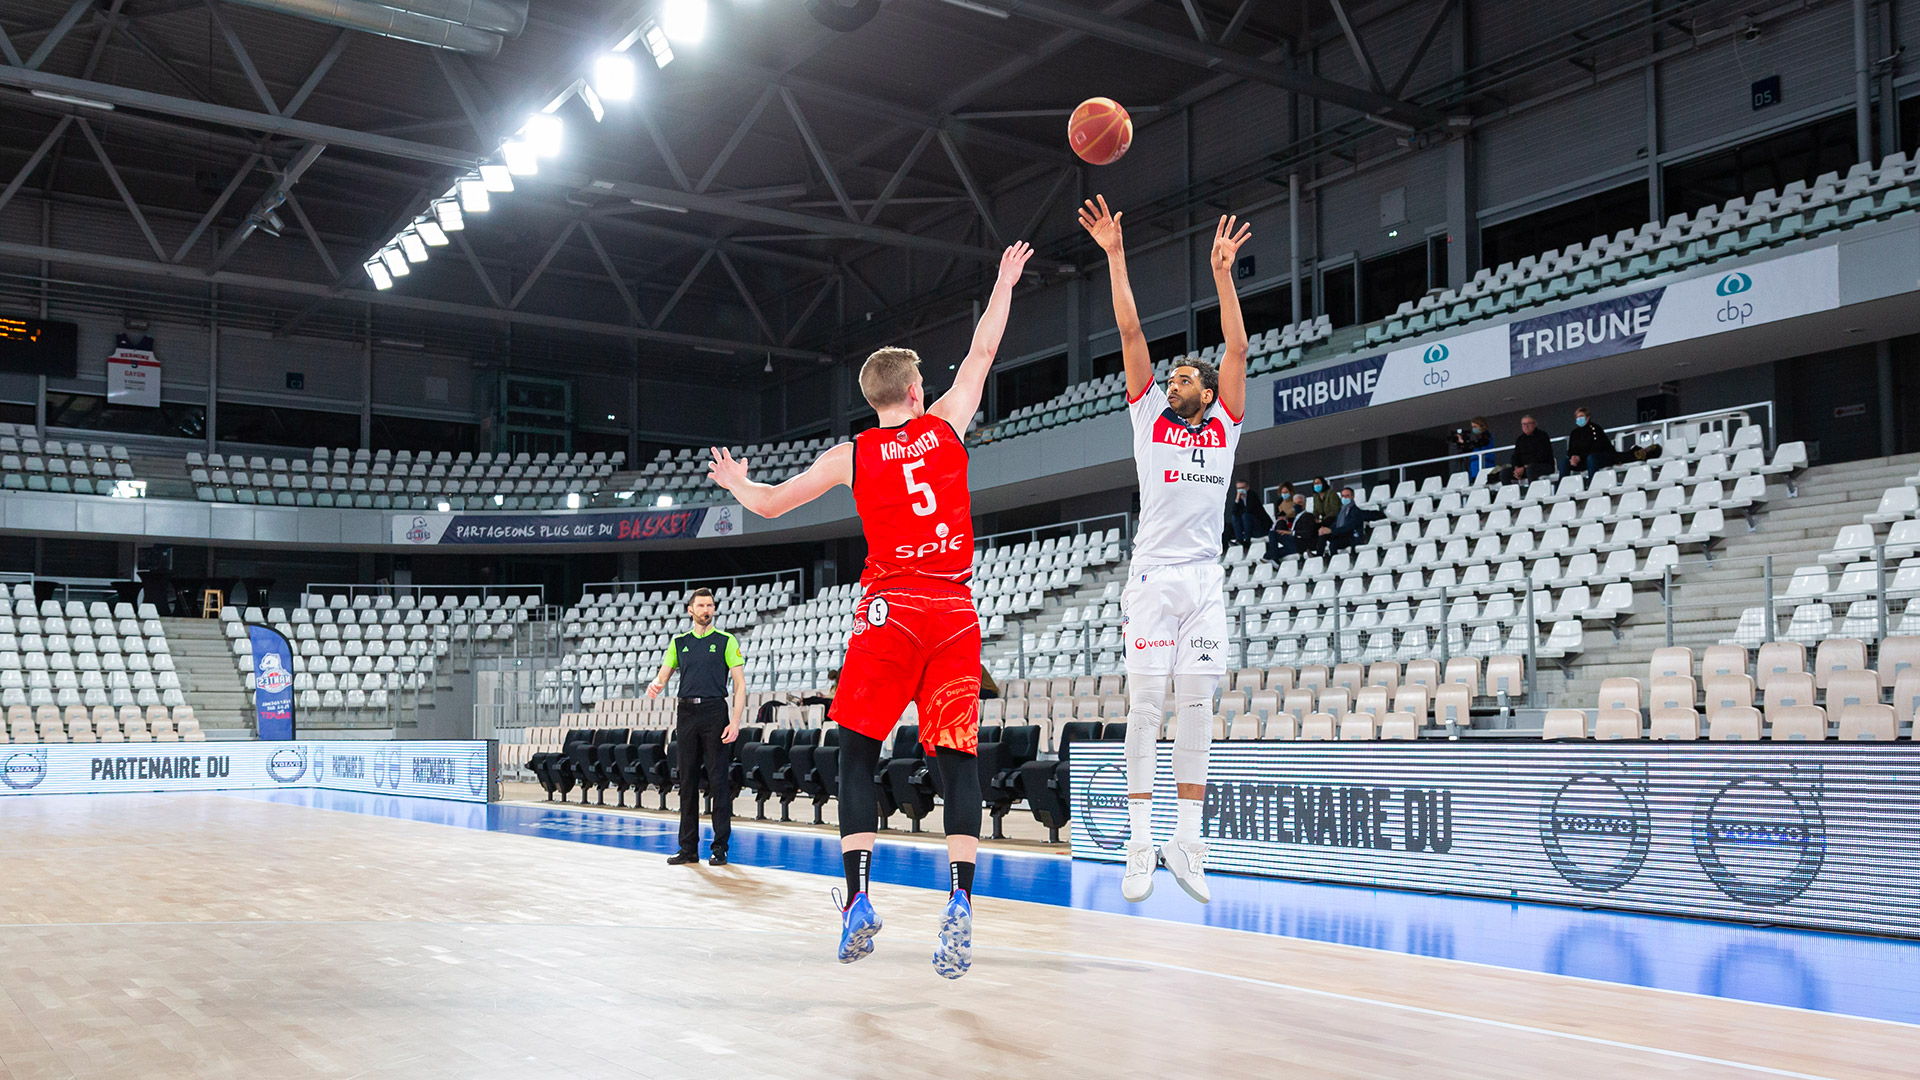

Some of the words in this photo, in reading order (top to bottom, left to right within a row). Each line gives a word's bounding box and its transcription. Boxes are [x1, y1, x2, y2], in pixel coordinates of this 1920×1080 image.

[1717, 300, 1754, 324] cbp
[1517, 304, 1652, 359] TRIBUNE
[1423, 367, 1450, 388] cbp
[1278, 368, 1378, 412] TRIBUNE
[1191, 448, 1205, 469] 4
[902, 458, 937, 516] 5
[1181, 473, 1225, 486] LEGENDRE
[456, 525, 535, 538] PARTAGEONS
[540, 524, 570, 538] PLUS
[573, 524, 594, 536] QUE
[598, 523, 614, 536] DU
[617, 512, 691, 540] BASKET
[895, 523, 965, 559] SPIE
[875, 603, 881, 622] 5
[1147, 639, 1176, 648] VEOLIA
[1190, 636, 1220, 650] idex
[91, 756, 201, 780] PARTENAIRE
[207, 755, 230, 778] DU
[1089, 795, 1130, 807] VOLVO
[1203, 783, 1391, 850] PARTENAIRE
[1404, 789, 1452, 854] DU
[1555, 816, 1633, 833] VOLVO
[1711, 823, 1803, 841] VOLVO
